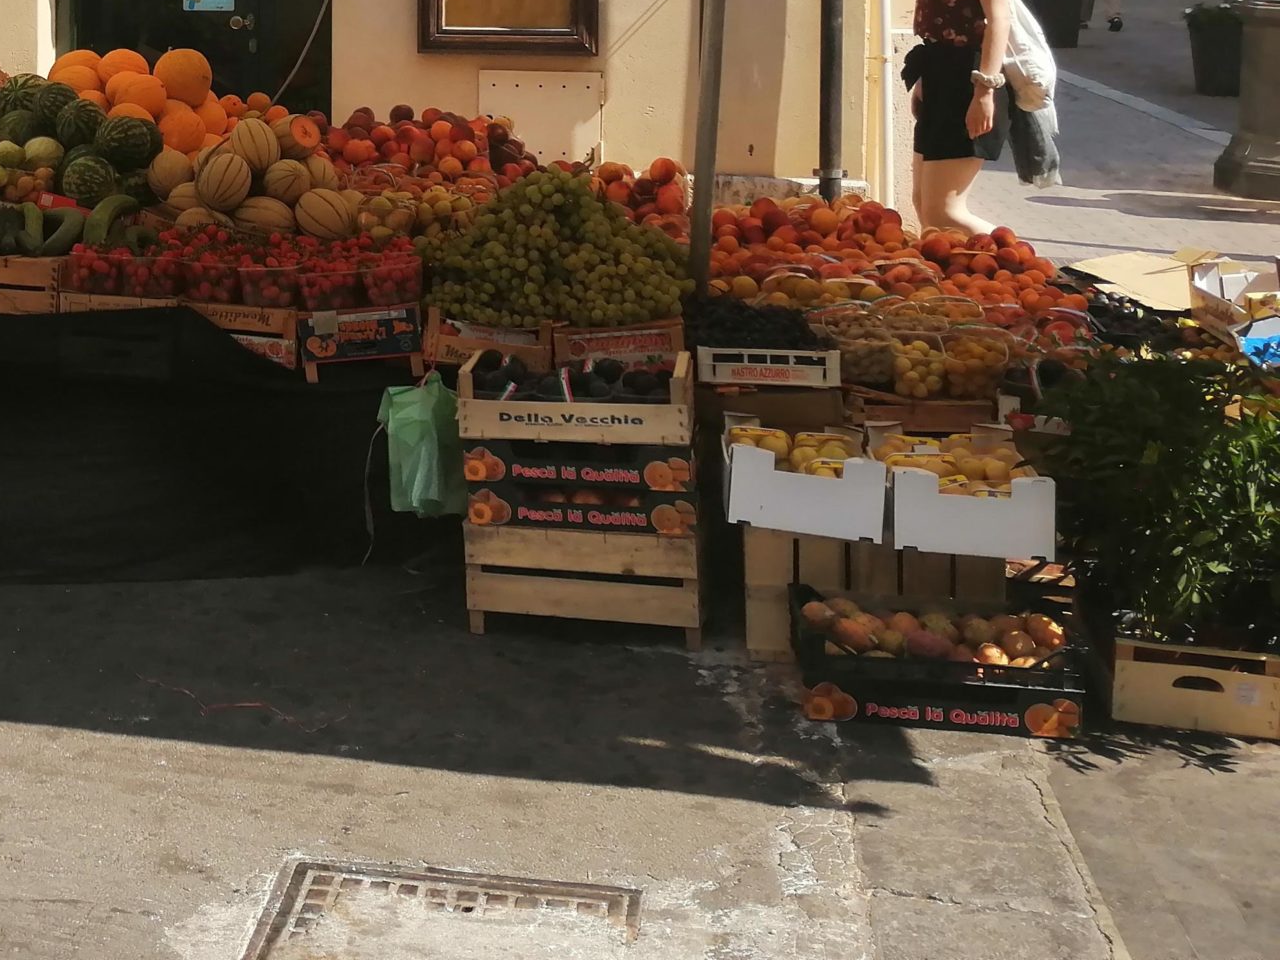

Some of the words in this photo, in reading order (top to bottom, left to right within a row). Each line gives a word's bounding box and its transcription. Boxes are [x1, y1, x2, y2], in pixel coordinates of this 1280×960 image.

[759, 368, 791, 379] AZZURRO
[498, 411, 553, 423] Della
[560, 413, 644, 425] Vecchia
